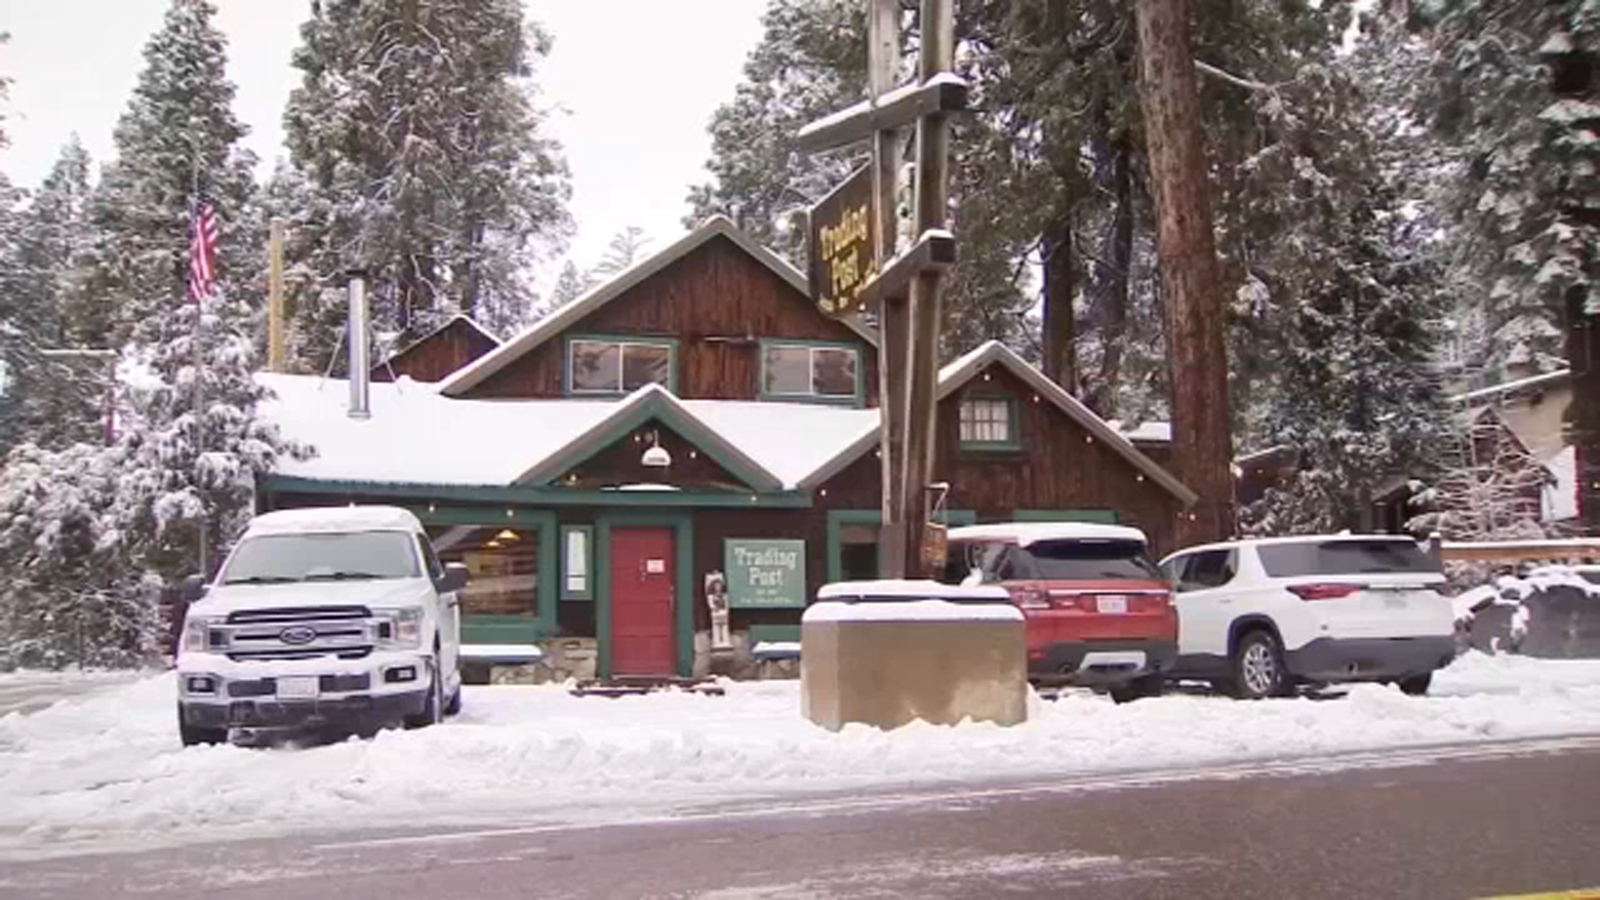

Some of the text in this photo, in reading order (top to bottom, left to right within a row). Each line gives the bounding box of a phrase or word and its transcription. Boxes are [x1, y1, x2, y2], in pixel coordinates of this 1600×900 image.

[820, 205, 868, 261] Trading
[832, 246, 859, 296] Post
[734, 547, 797, 570] Trading
[749, 567, 783, 585] Post
